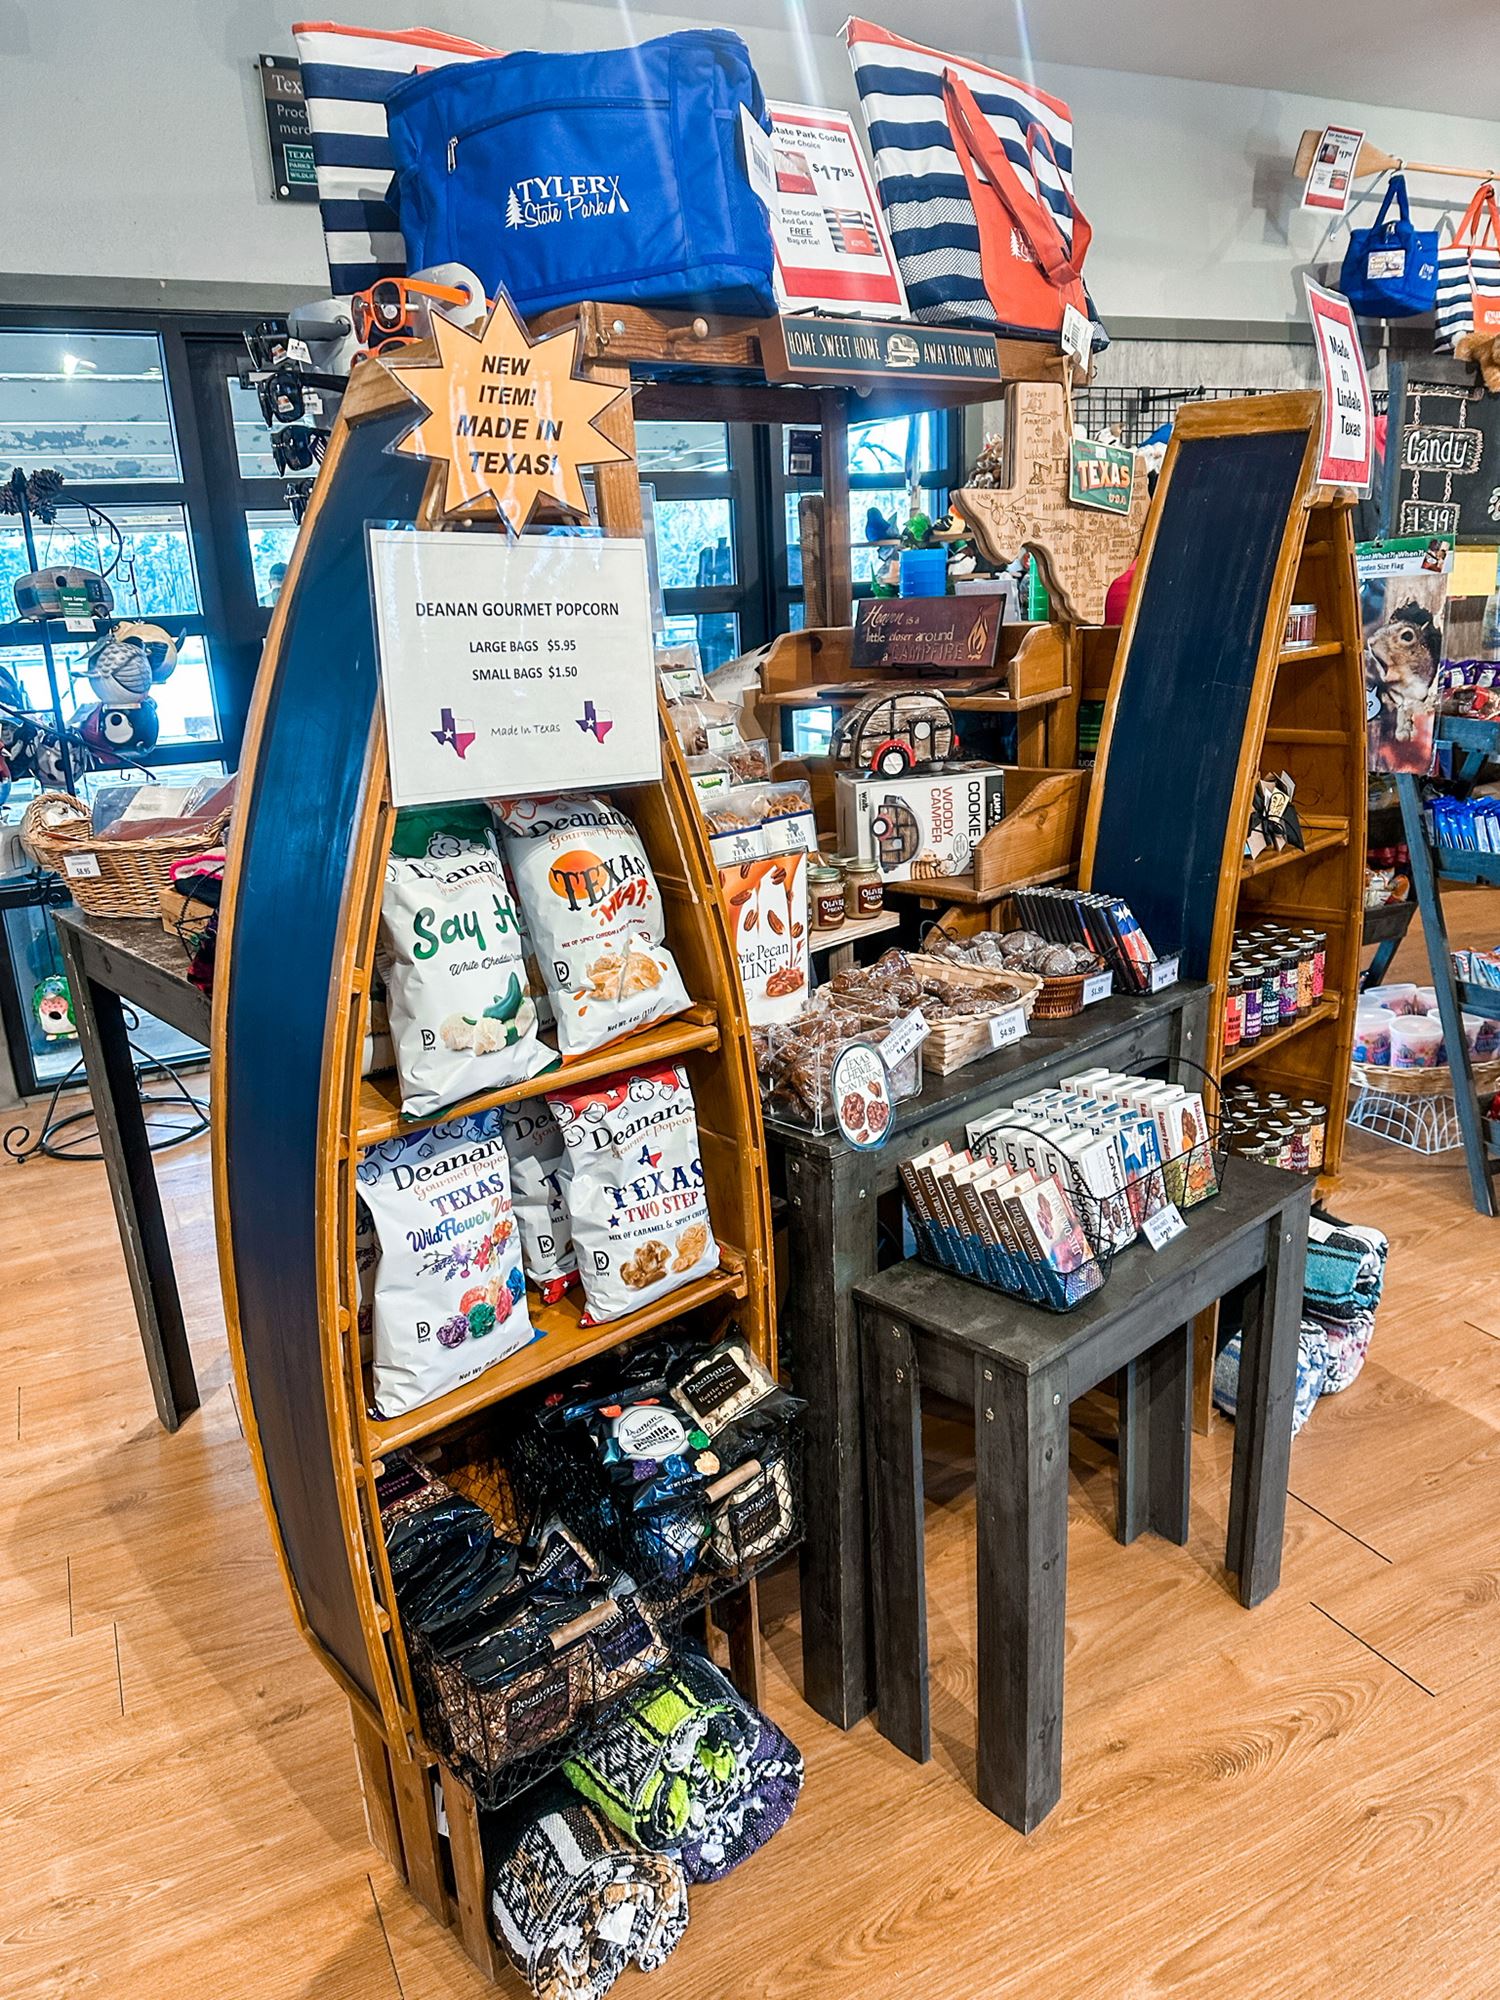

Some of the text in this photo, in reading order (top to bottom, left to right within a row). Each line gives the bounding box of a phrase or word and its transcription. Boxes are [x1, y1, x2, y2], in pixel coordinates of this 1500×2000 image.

[779, 136, 821, 149] Your Choice
[796, 129, 816, 140] Park
[818, 132, 846, 144] Cooler
[516, 176, 610, 203] TYLER
[524, 193, 608, 228] State Park
[788, 332, 997, 368] HOME SWEET HOME AWAY FROM HOME
[1329, 335, 1350, 360] Made
[482, 354, 530, 376] NEW
[1340, 366, 1350, 383] in
[478, 384, 536, 407] ITEM!
[1336, 388, 1362, 412] Lindale
[456, 415, 563, 441] MADE IN
[1340, 415, 1362, 437] Texas
[1406, 430, 1468, 468] Candy
[468, 451, 558, 476] TEXAS!
[1077, 460, 1130, 492] TEXAS
[416, 602, 620, 617] DEANAN GOURMET POPCORN
[862, 604, 904, 628] Heaven
[906, 616, 914, 624] is
[866, 624, 954, 643] little closer around
[470, 639, 577, 653] LARGE BAGS $5.95
[882, 643, 964, 662] a CAMPFIRE
[472, 666, 578, 680] SMALL BAGS $1.50
[490, 726, 519, 736] Made
[534, 724, 560, 734] Texas
[931, 788, 942, 844] CAMPER
[942, 786, 954, 836] WOODY
[968, 781, 981, 837] COOKIE
[528, 811, 632, 838] Deanan
[786, 830, 805, 840] TEXAS
[548, 829, 600, 850] Gourmet
[550, 855, 646, 912] TEXAS
[600, 878, 648, 922] HEAT
[413, 907, 486, 960] Say
[580, 936, 594, 944] SPICY
[757, 943, 789, 960] Pecan
[449, 960, 480, 976] White
[607, 1024, 618, 1032] Net
[1000, 1026, 1016, 1038] $4.99
[883, 1034, 897, 1050] TEXAS
[840, 1063, 876, 1084] CHEWIE
[845, 1052, 870, 1073] TEXAS
[590, 1104, 688, 1151] Deanan
[612, 1130, 650, 1159] Gourmet
[390, 1139, 504, 1192] Deanan
[414, 1166, 470, 1202] Gourmet
[430, 1172, 504, 1217] TEXAS
[604, 1158, 705, 1210] TEXAS
[624, 1191, 699, 1224] TWO STEP
[634, 1224, 666, 1238] CARAMEL
[675, 1215, 691, 1225] SPICY
[686, 1364, 729, 1395] Deanan
